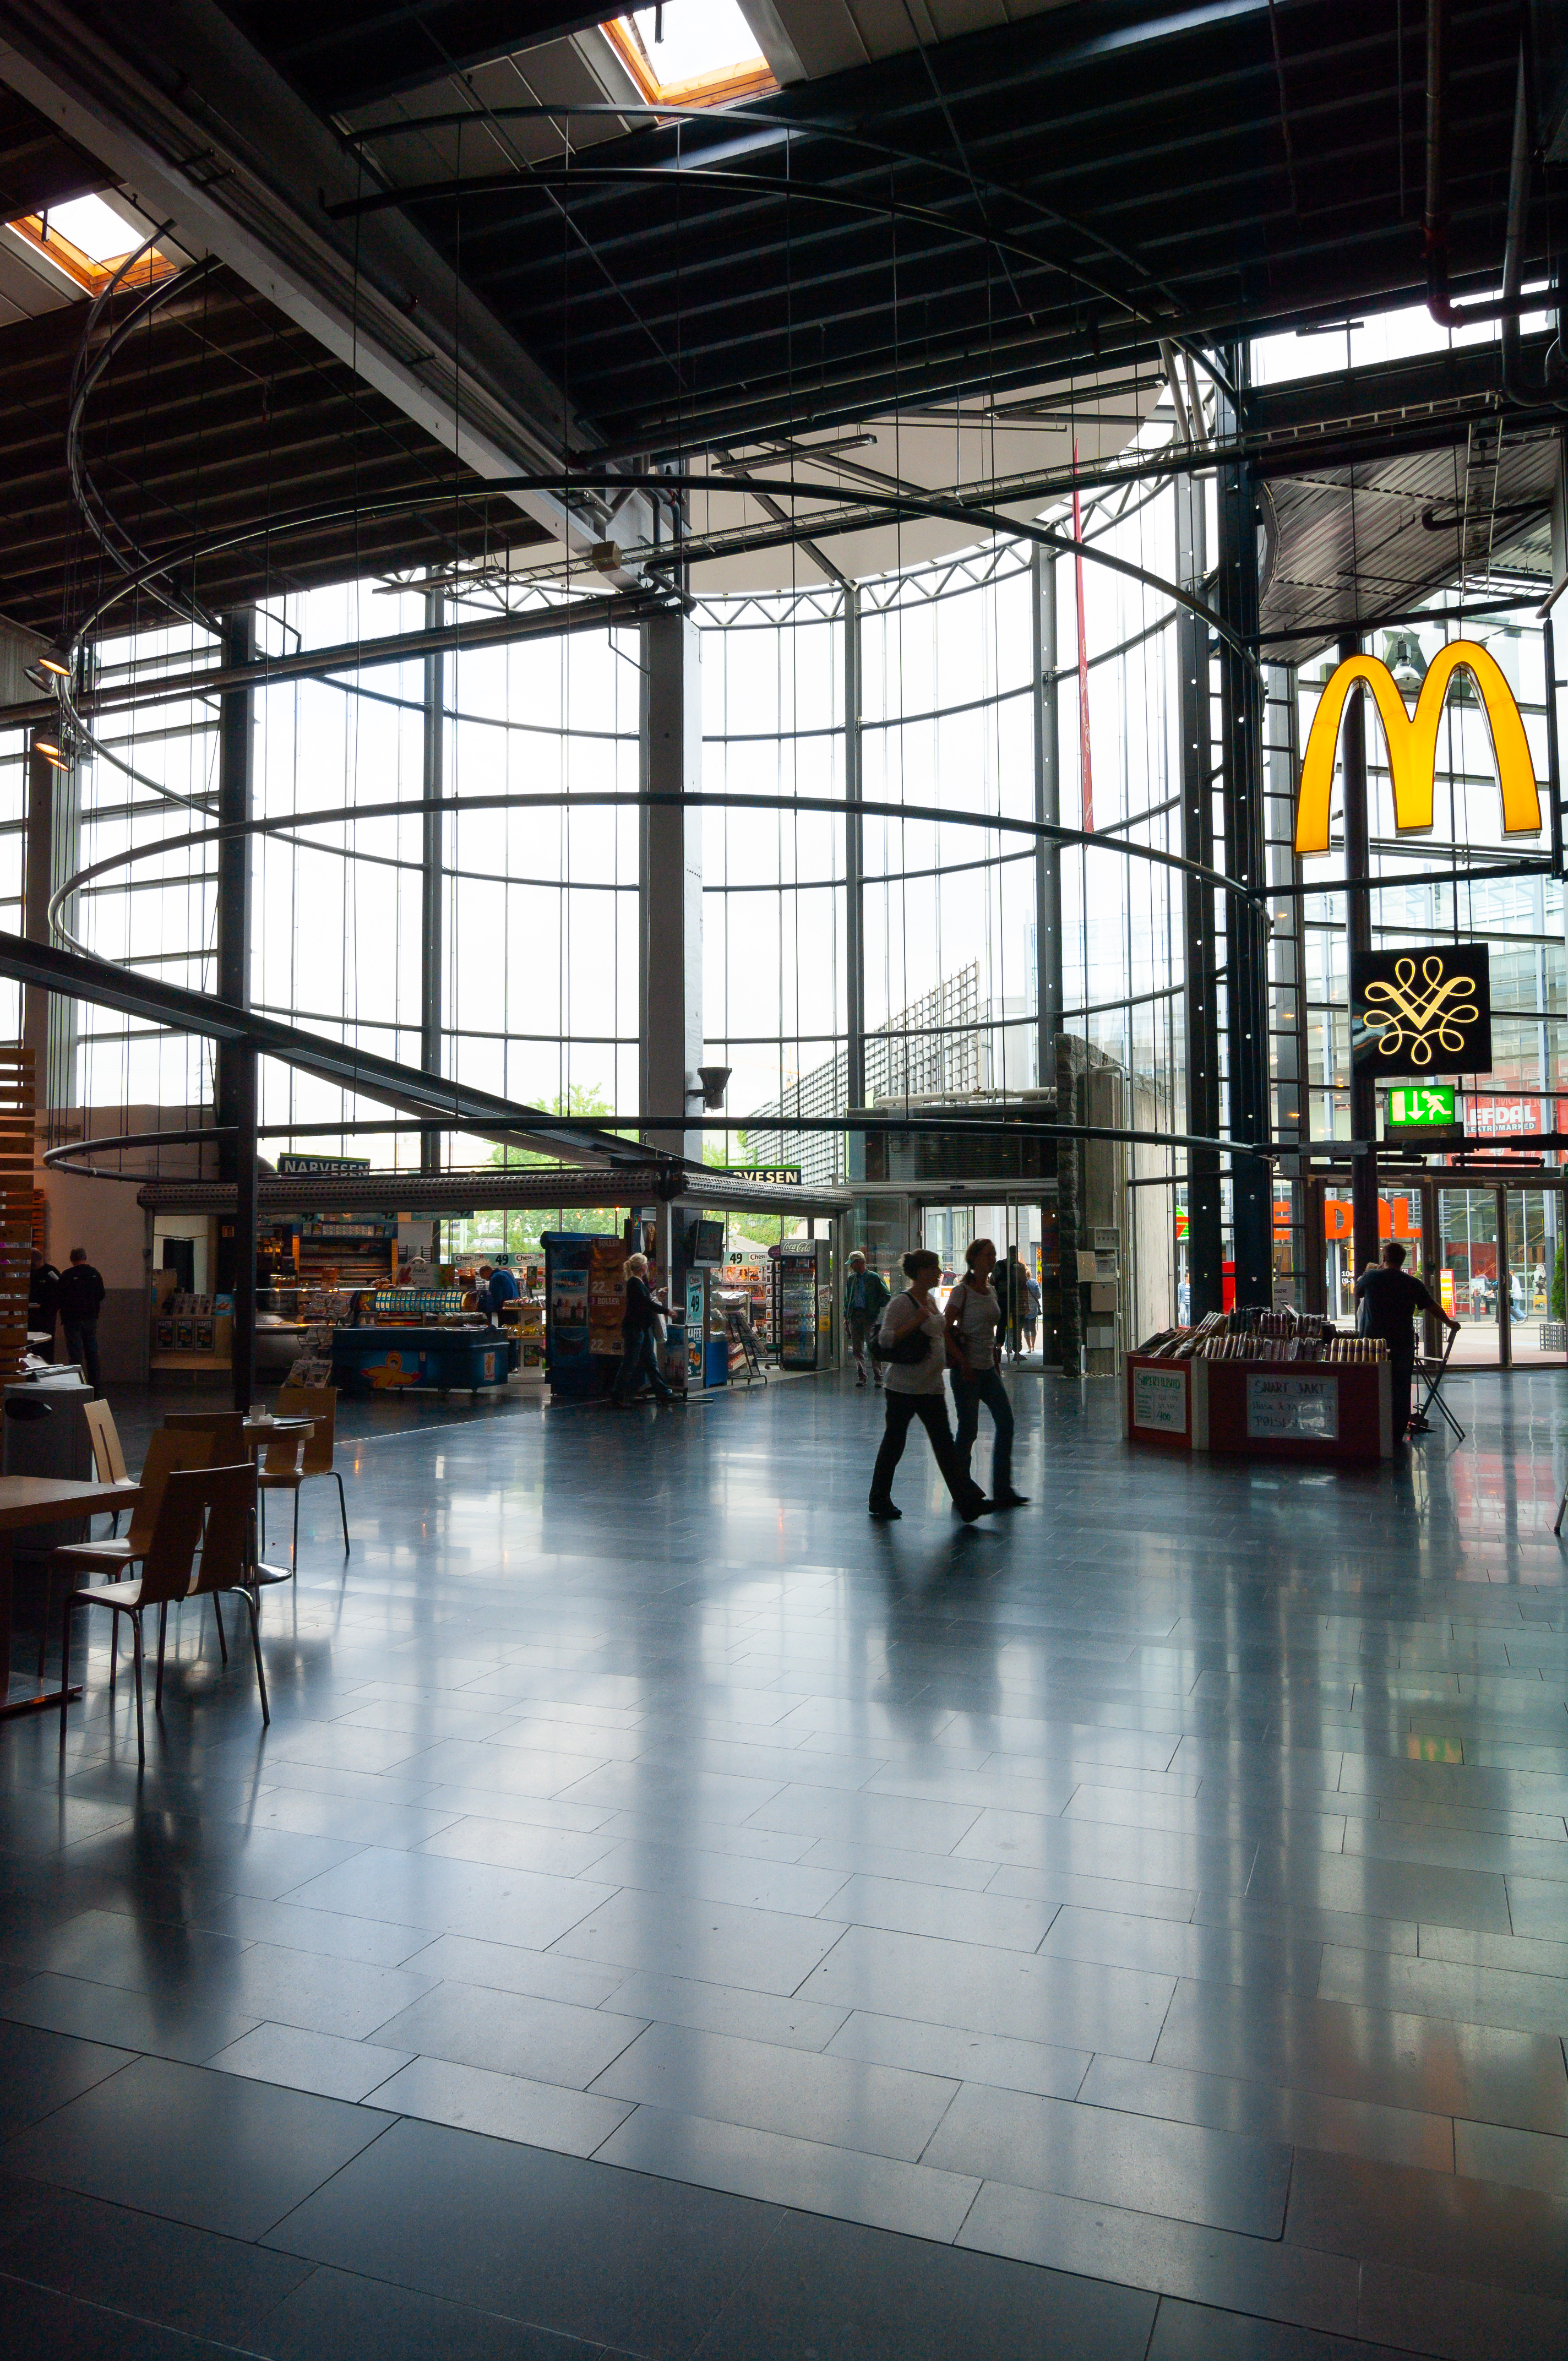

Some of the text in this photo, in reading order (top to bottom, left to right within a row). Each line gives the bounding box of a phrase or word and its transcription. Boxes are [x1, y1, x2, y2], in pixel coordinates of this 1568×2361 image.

[1468, 1105, 1536, 1125] EFDAL
[1467, 1123, 1535, 1133] LEKTROMARKED
[285, 1160, 369, 1176] NARVESEN
[496, 1254, 508, 1265] 49
[729, 1253, 743, 1264] 49
[691, 1295, 700, 1312] 49
[688, 1328, 702, 1338] KAFFE
